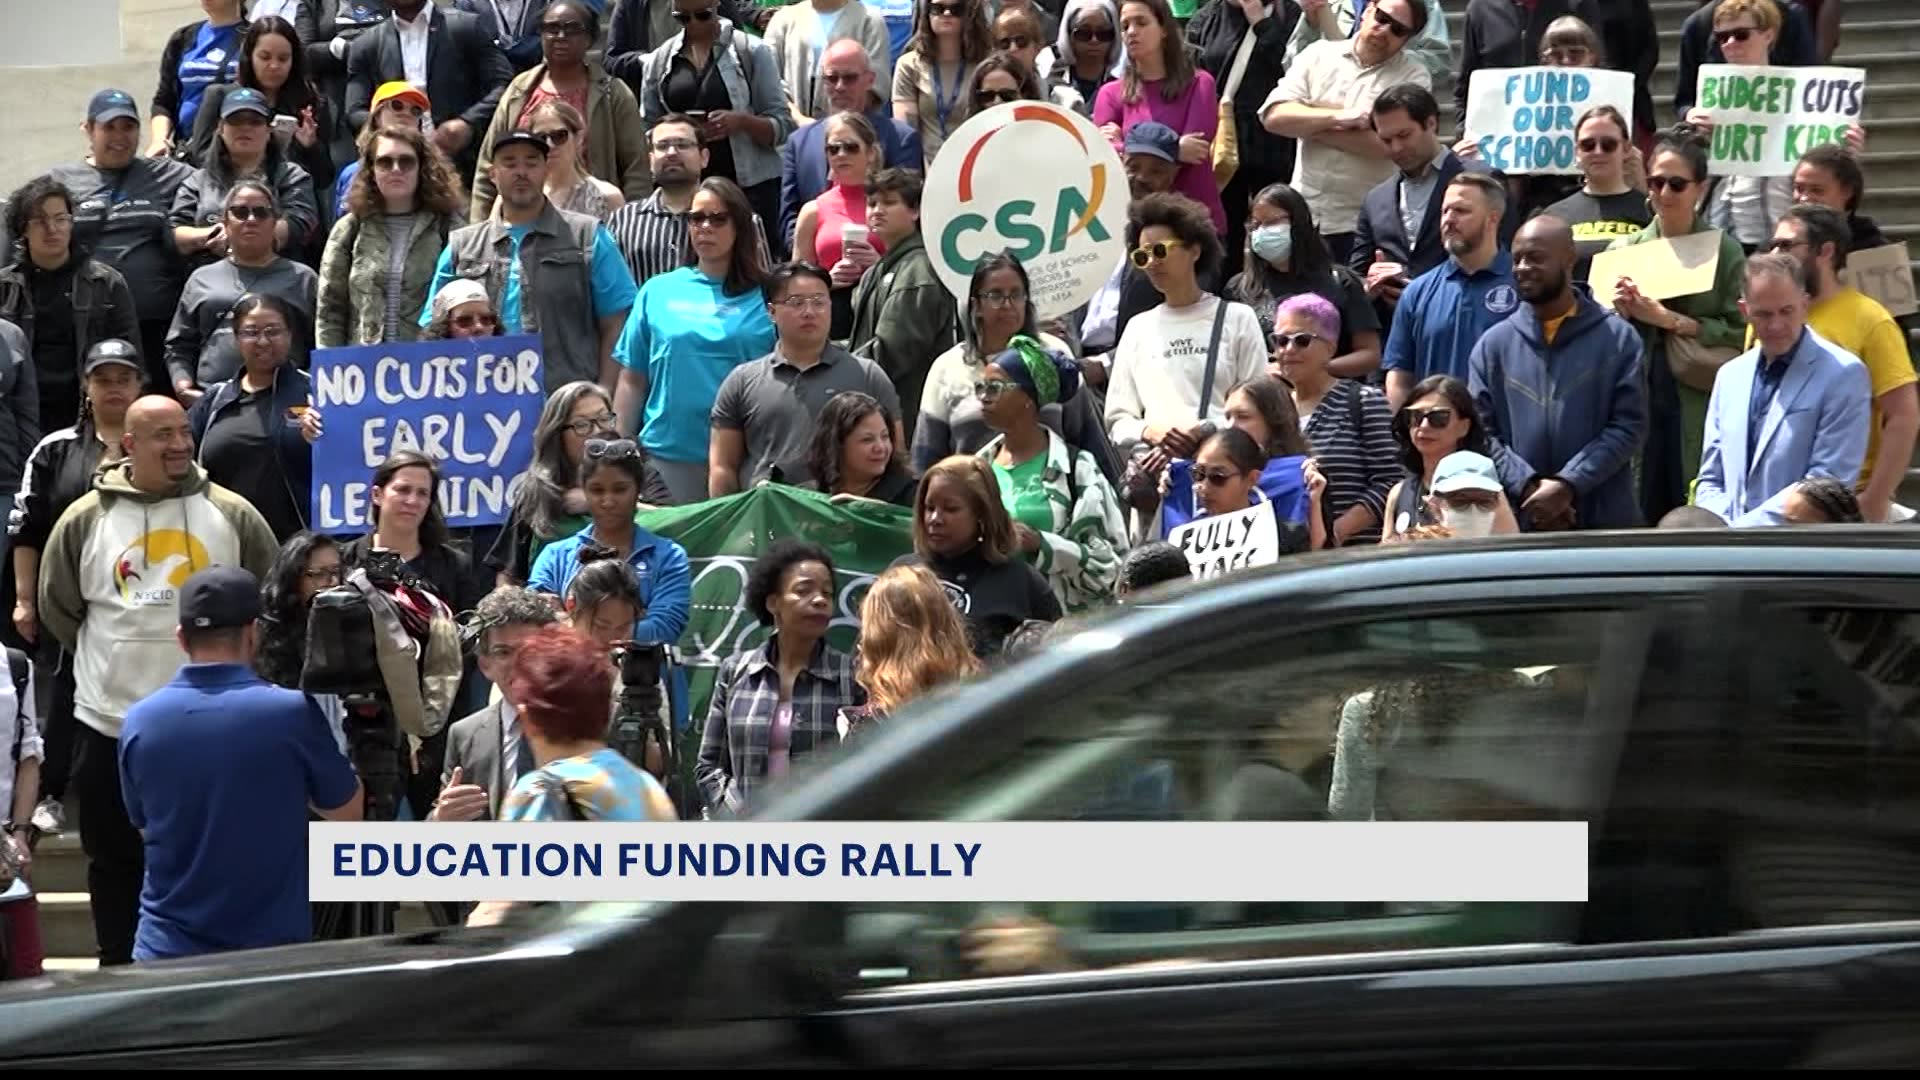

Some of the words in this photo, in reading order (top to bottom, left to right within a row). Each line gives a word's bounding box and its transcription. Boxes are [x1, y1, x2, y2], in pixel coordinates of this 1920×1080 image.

[1505, 72, 1591, 104] FUND
[1702, 76, 1796, 113] BUDGET
[1802, 78, 1863, 116] CUTS
[1513, 105, 1574, 132] OUR
[1477, 134, 1575, 170] SCHOO
[1705, 123, 1767, 162] URT
[941, 186, 1111, 276] CSA
[317, 365, 365, 407] NO
[375, 357, 467, 403] CUTS
[475, 350, 539, 395] FOR
[363, 410, 520, 467] EARLY
[320, 474, 528, 528] LEIN
[1181, 515, 1257, 554] FULLY
